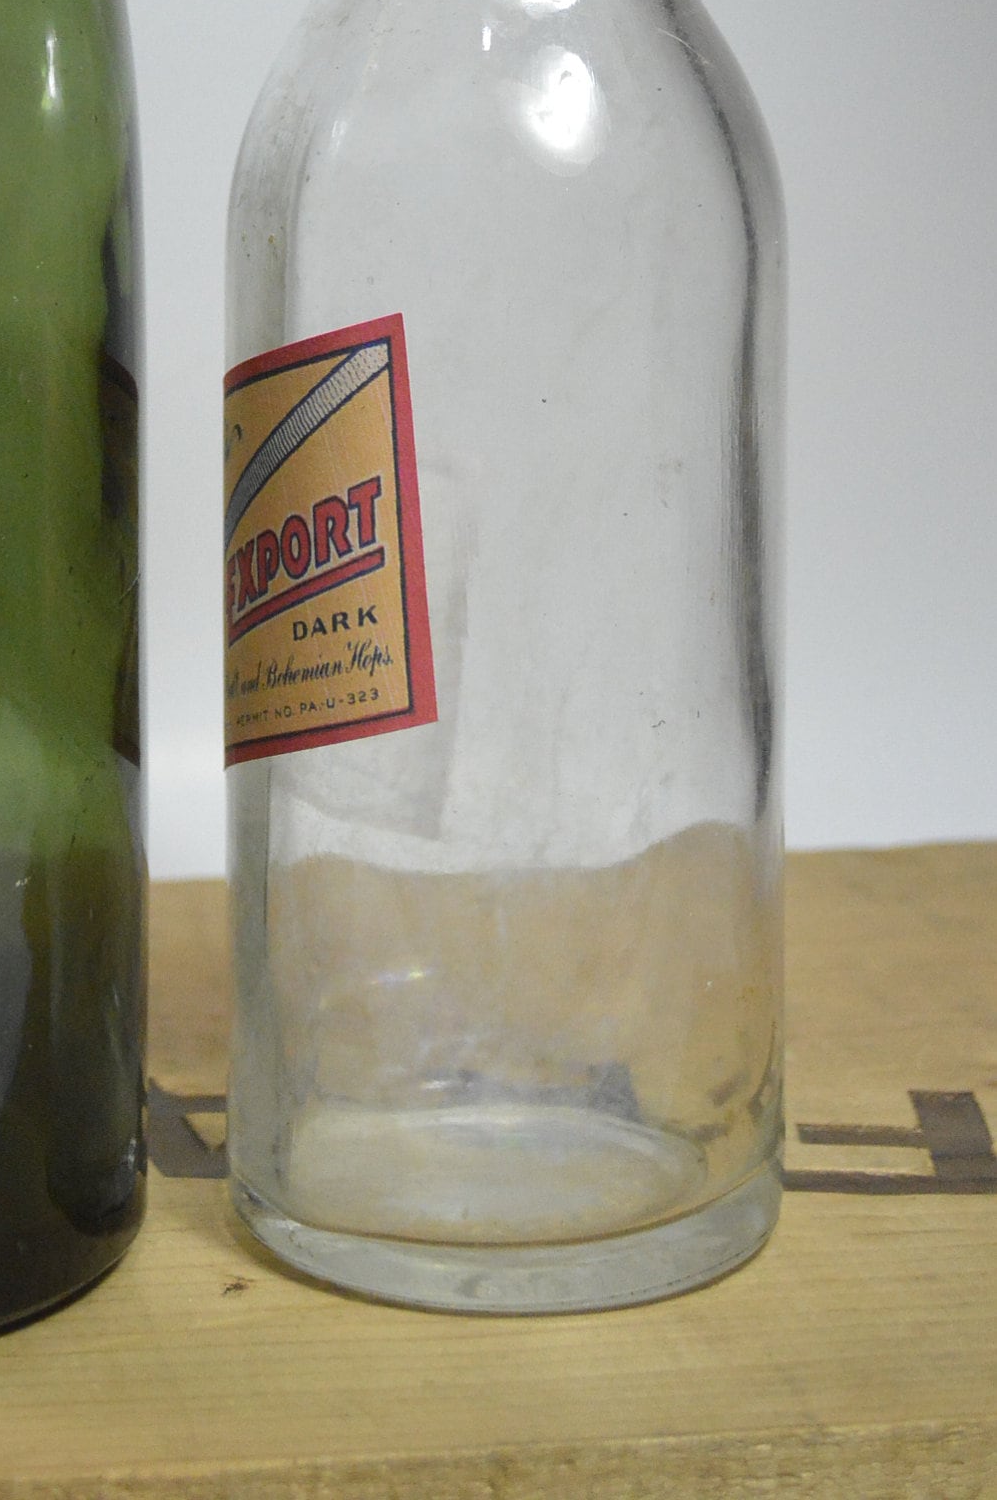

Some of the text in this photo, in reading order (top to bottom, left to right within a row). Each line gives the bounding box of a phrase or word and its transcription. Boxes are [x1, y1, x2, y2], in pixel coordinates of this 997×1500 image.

[226, 475, 383, 617] EXPORT
[292, 605, 379, 641] DARK
[266, 653, 344, 691] Bohemian
